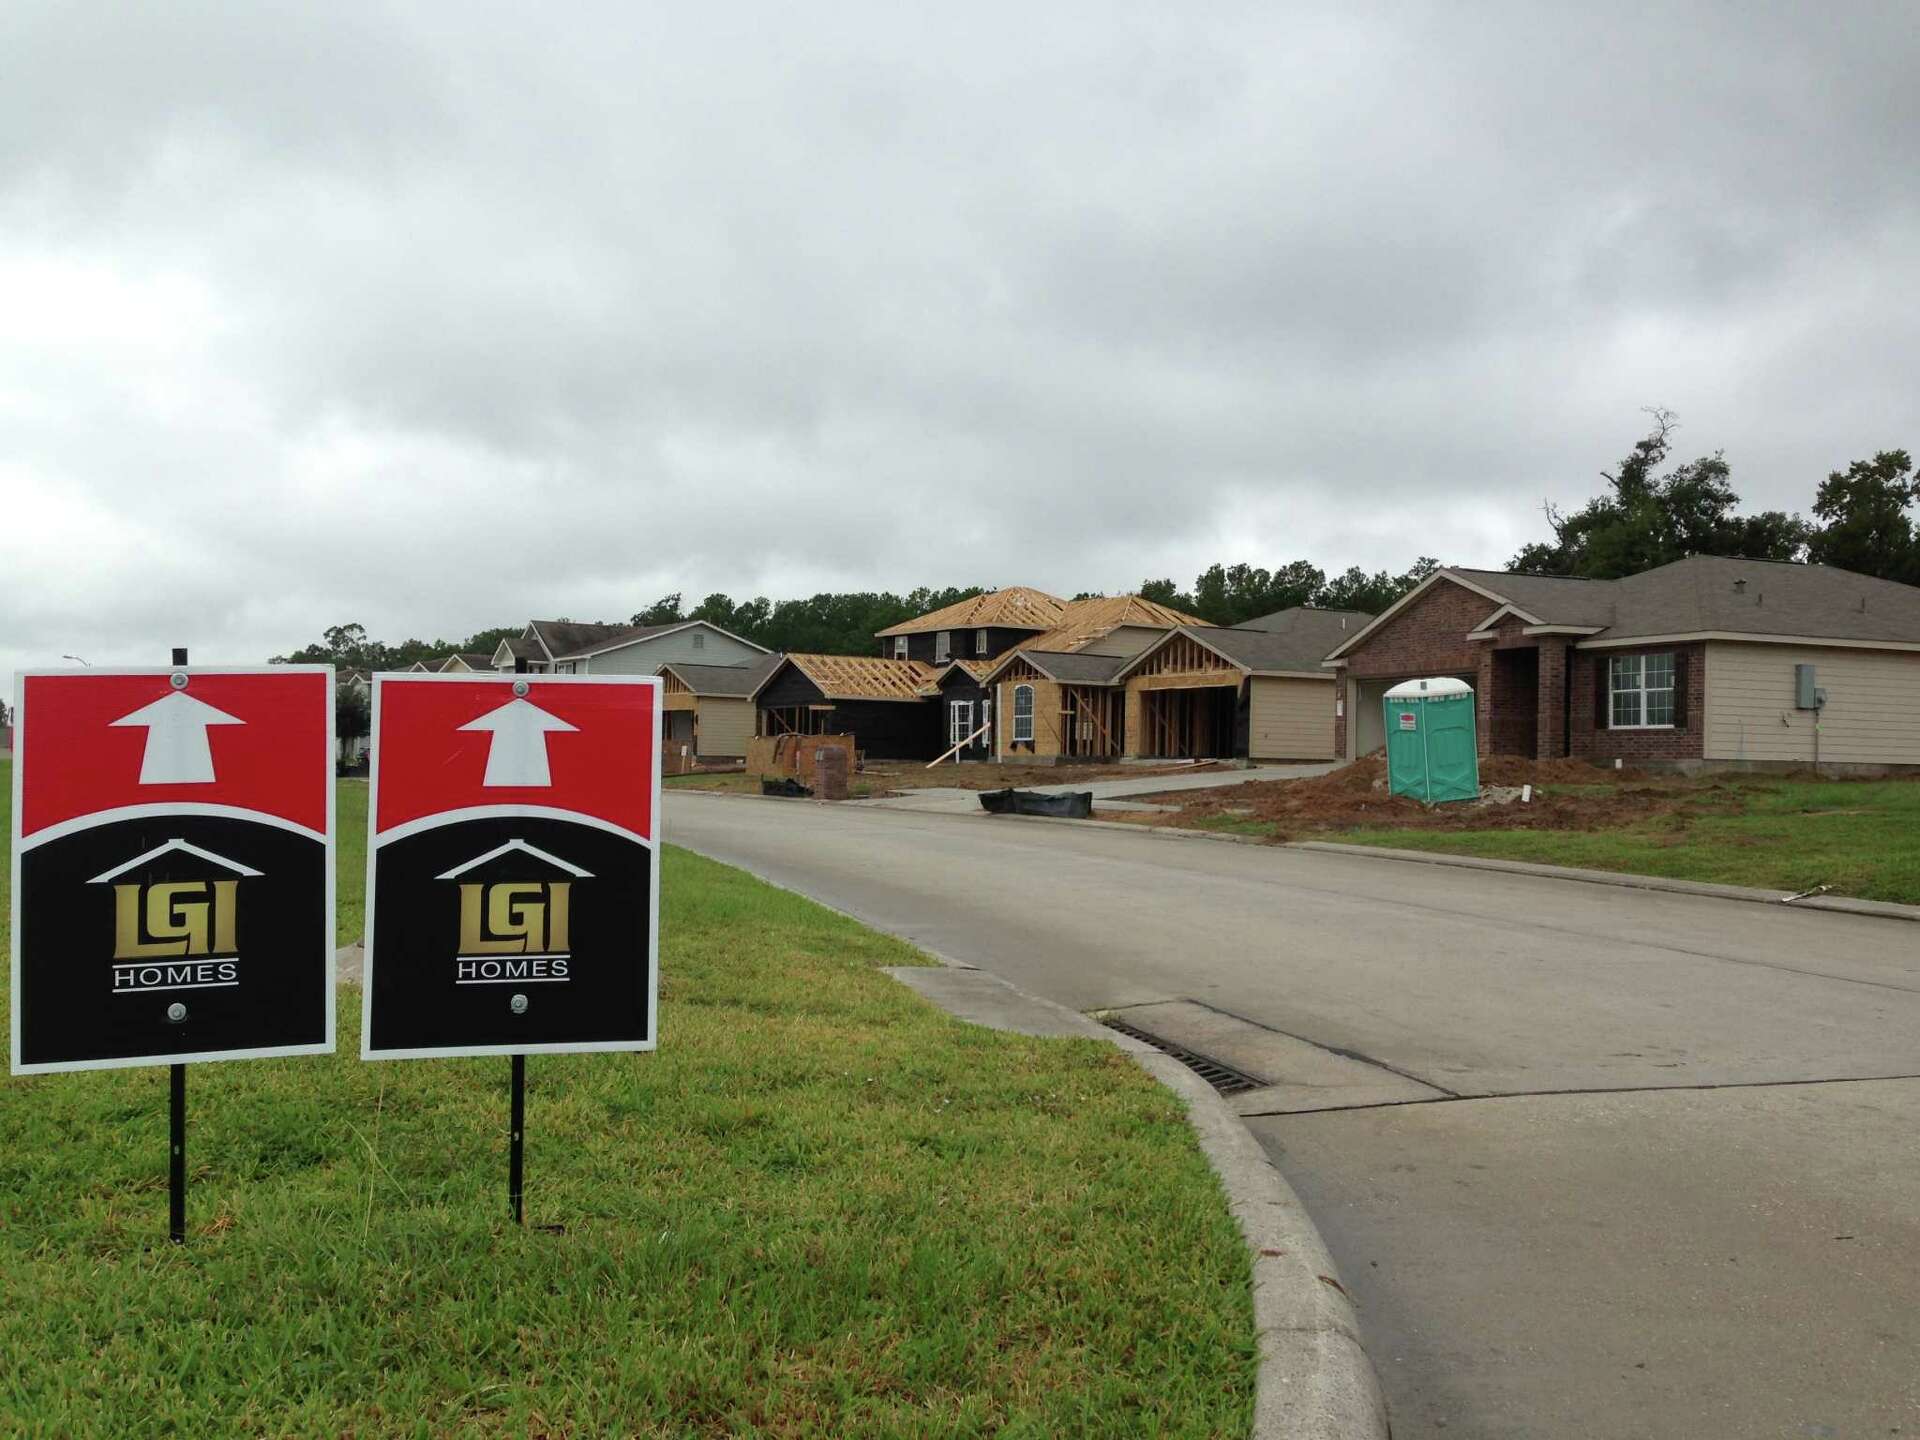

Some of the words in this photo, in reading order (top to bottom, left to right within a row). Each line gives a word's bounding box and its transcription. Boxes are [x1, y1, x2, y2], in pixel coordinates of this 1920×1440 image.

[113, 880, 239, 959] LGI
[457, 882, 572, 954] LGI
[114, 963, 237, 986] HOMES
[458, 960, 568, 978] HOMES
